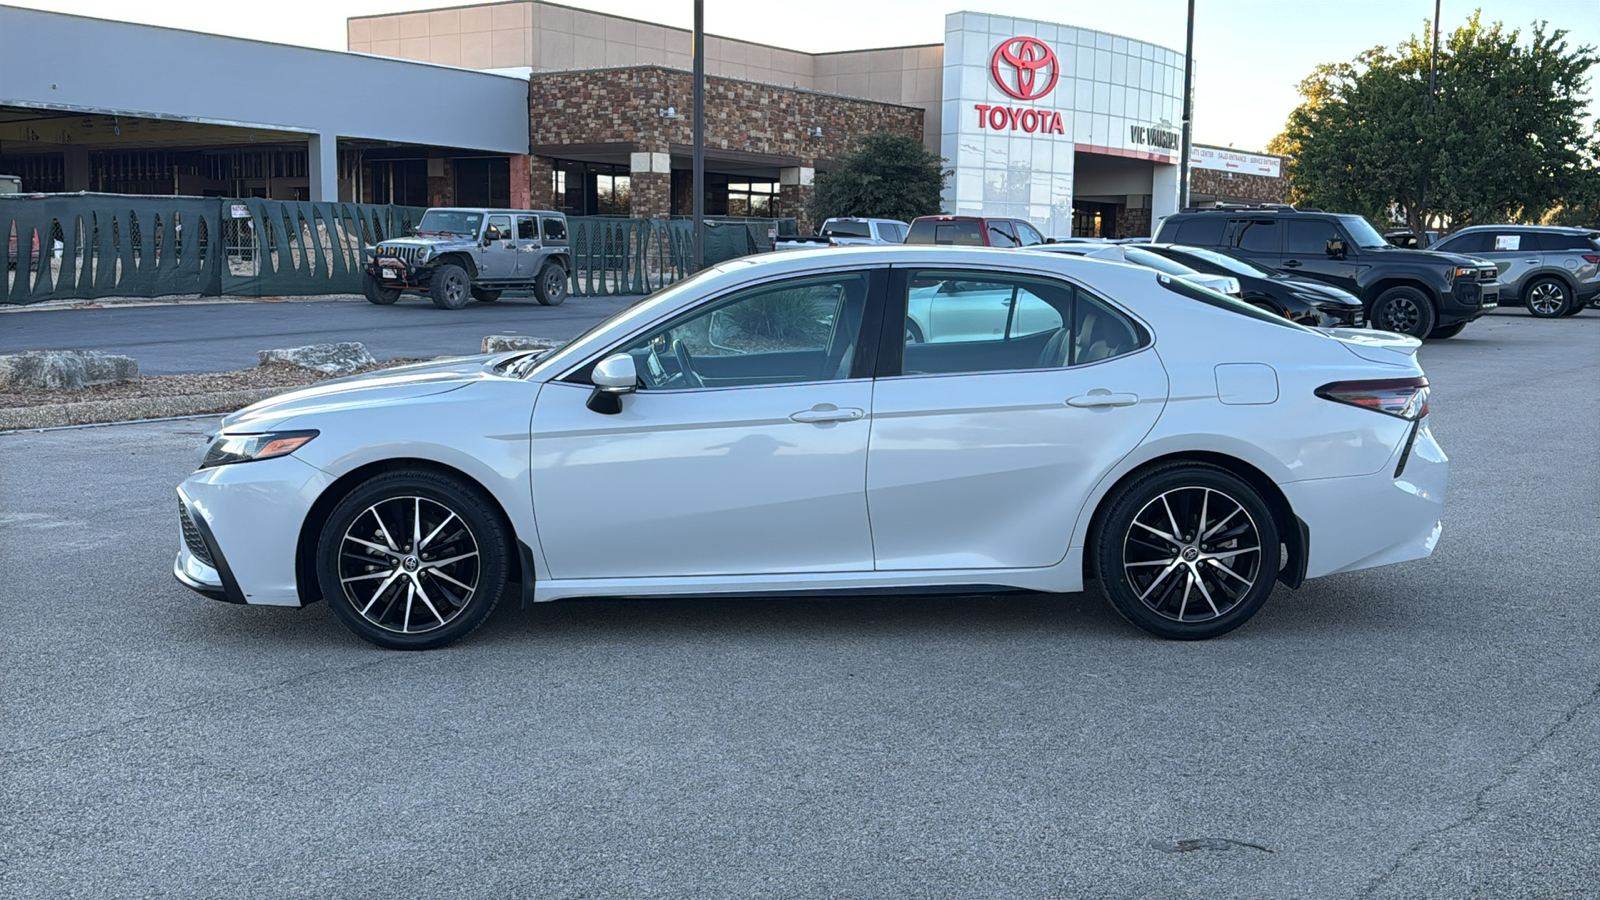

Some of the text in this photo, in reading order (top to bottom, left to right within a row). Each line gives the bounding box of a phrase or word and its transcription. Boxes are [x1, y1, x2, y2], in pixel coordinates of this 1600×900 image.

[974, 104, 1065, 135] TOYOTA
[1130, 125, 1145, 145] VIC
[1200, 150, 1214, 158] CENTER
[1218, 152, 1247, 163] SALES ENTRANCE
